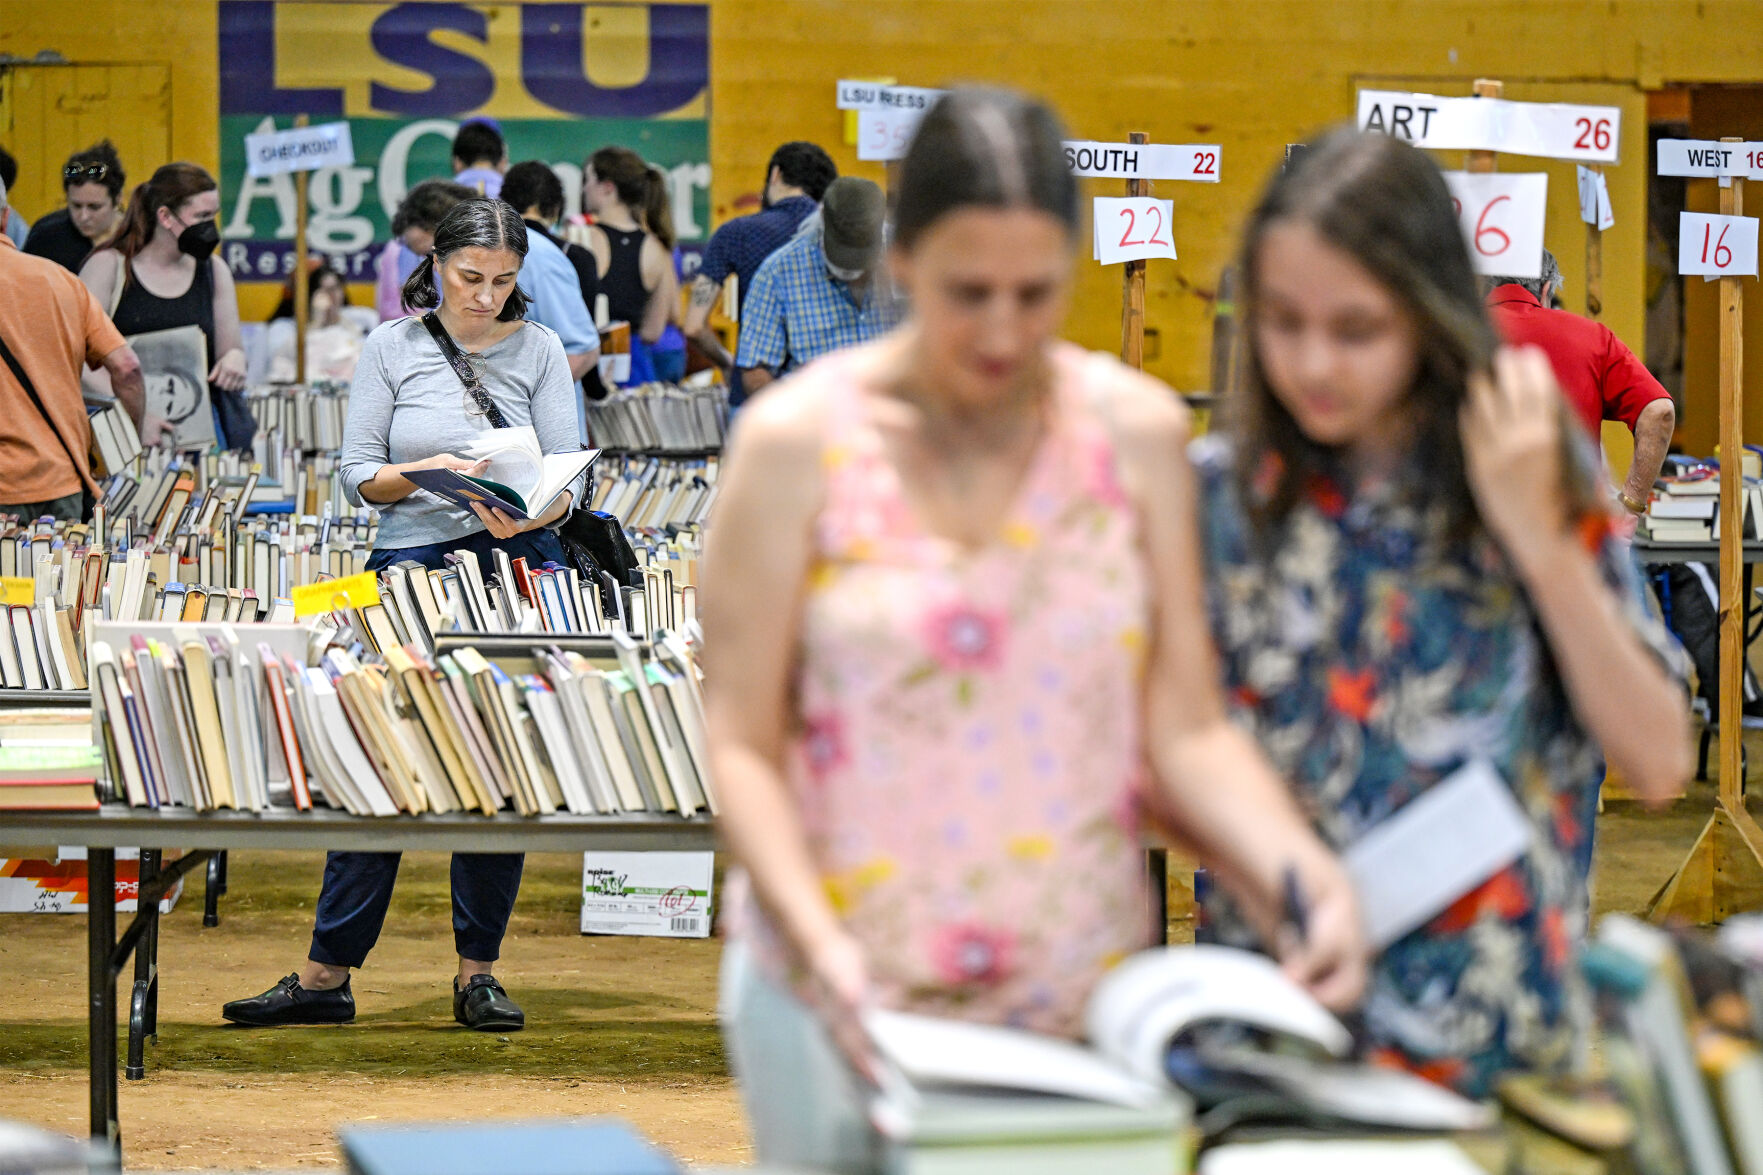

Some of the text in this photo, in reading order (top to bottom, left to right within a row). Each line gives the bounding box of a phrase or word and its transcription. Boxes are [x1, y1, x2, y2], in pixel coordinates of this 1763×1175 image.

[219, 3, 710, 117] LSU
[842, 87, 875, 104] LSU
[1366, 103, 1611, 151] ART 26
[1064, 147, 1215, 174] SOUTH 22
[1687, 149, 1763, 169] WEST 16
[1119, 206, 1169, 247] 22
[1701, 222, 1732, 268] 16
